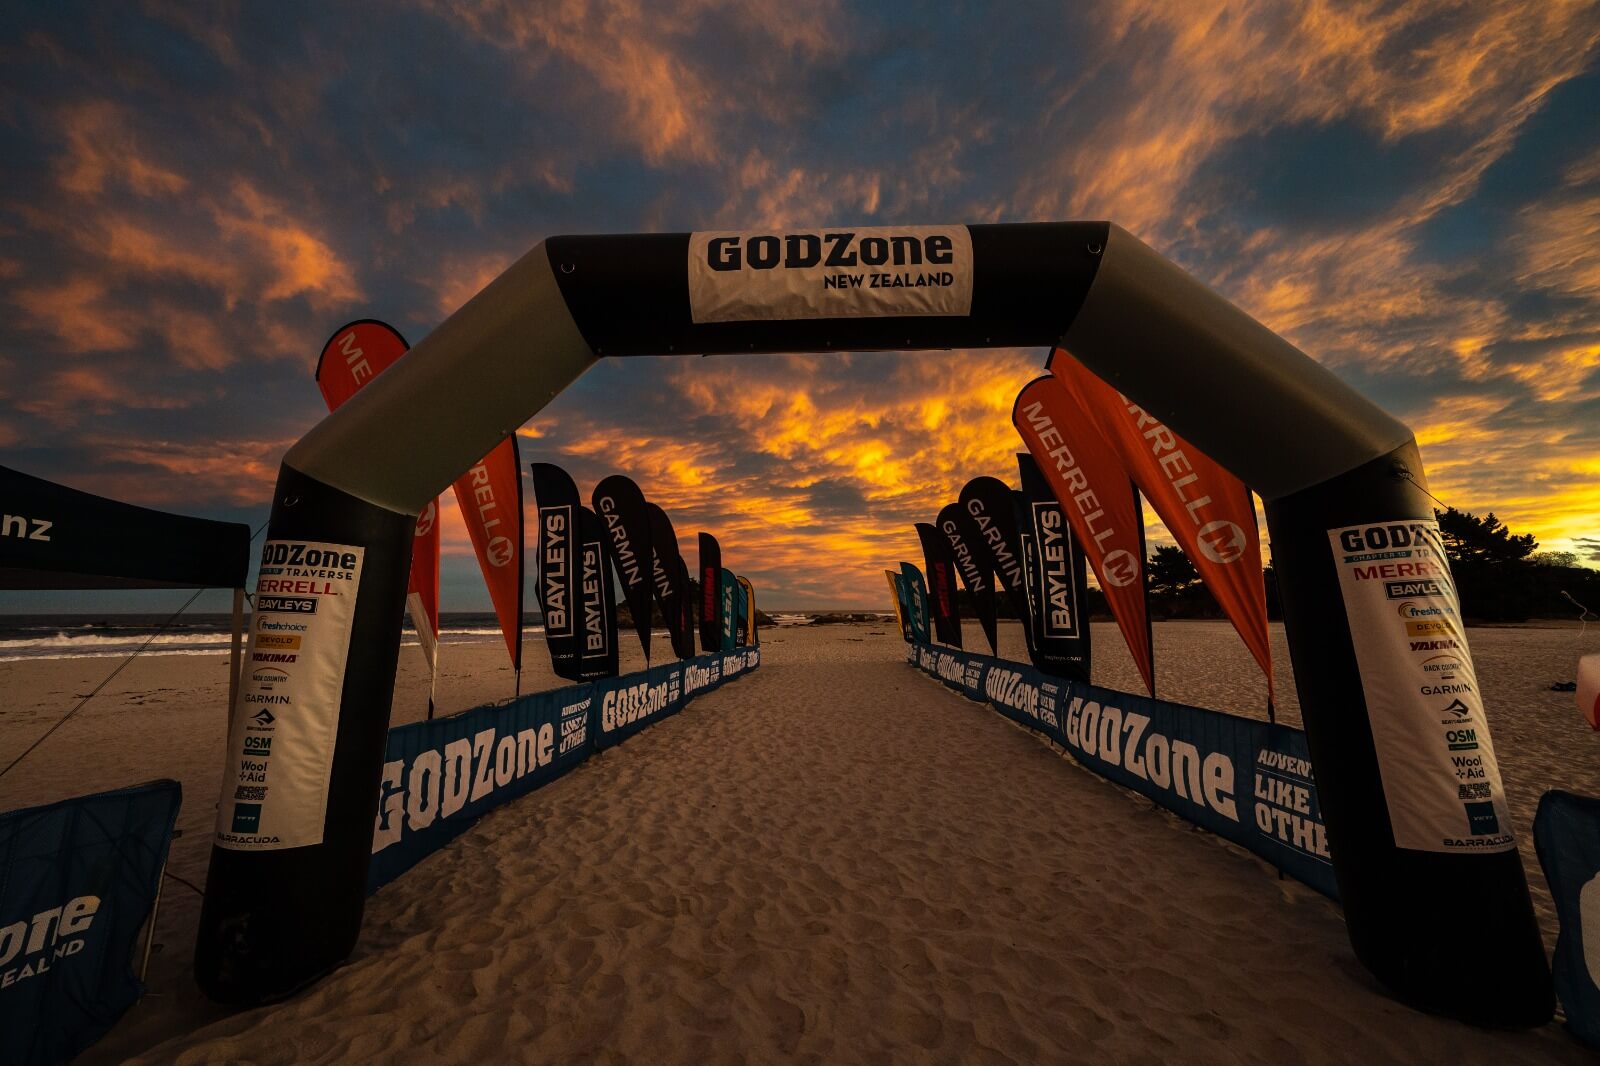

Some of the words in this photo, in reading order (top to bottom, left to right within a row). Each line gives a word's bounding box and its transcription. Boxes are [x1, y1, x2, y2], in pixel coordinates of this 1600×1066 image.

[707, 233, 953, 271] GODZone
[824, 274, 864, 289] NEW
[869, 272, 954, 288] ZEALAND
[1117, 390, 1213, 526] RRELL
[1023, 401, 1115, 554] MERRELL
[468, 459, 501, 540] RELL
[1, 513, 53, 542] nz
[600, 496, 644, 587] GARMIN
[967, 498, 1022, 588] GARMIN
[1340, 524, 1441, 552] GODZ
[261, 543, 357, 570] ODZone
[286, 567, 353, 581] TRAVERSE
[546, 514, 567, 629] BAYLEYS
[652, 546, 673, 598] MIN
[942, 520, 986, 593] GARMIN
[1041, 510, 1072, 629] BAYLEYS
[259, 599, 313, 611] BAYLEYS
[582, 550, 602, 651] BAYLEYS
[1391, 583, 1446, 596] BAYLE
[261, 621, 308, 632] freshchoice
[252, 652, 297, 663] YAKIMA
[245, 693, 290, 705] GARMIN
[601, 681, 668, 733] GODZone
[985, 666, 1040, 720] GODZone
[1420, 683, 1472, 696] GARMIN
[244, 736, 272, 749] OSM
[1445, 729, 1477, 743] OSM
[241, 760, 268, 772] Wool
[1066, 697, 1240, 823] GODZone
[1257, 748, 1315, 780] ADVEN
[1451, 755, 1482, 768] Wool
[371, 722, 555, 856] GODZone
[1254, 773, 1310, 816] LIKE
[1254, 801, 1332, 860] OTHE
